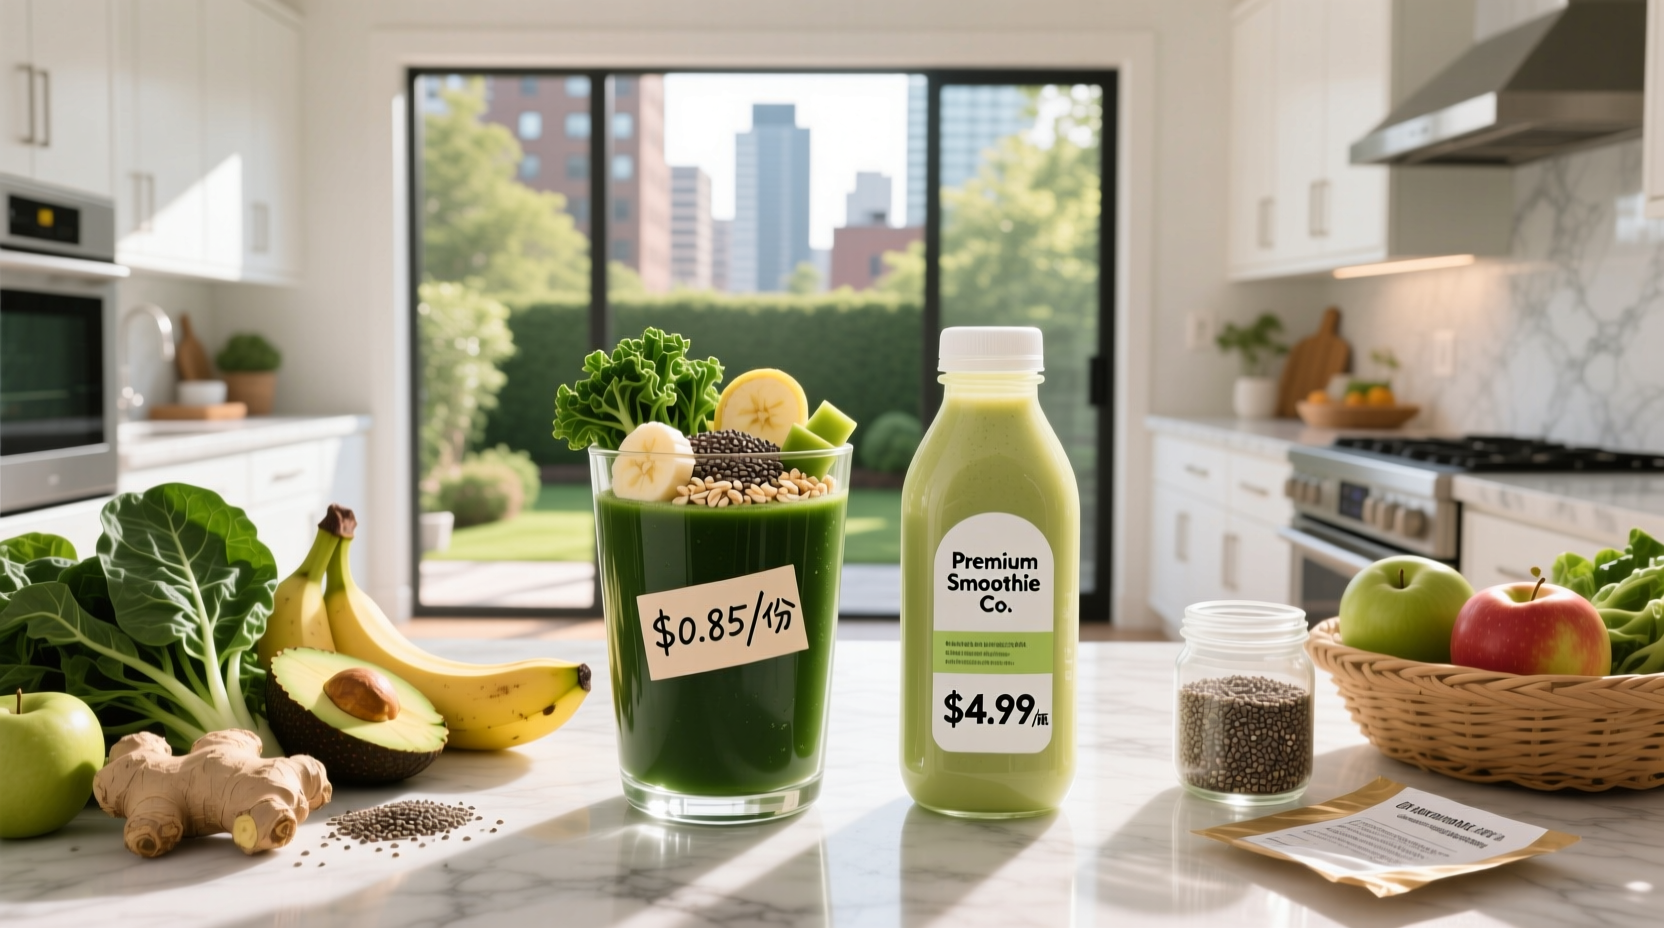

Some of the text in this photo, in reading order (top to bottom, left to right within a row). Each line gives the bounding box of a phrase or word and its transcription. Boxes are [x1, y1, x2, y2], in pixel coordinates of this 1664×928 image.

[952, 552, 1038, 570] Premium
[947, 573, 1041, 592] Smoothie
[979, 595, 1013, 613] Co.
[652, 590, 796, 657] $0.85/份
